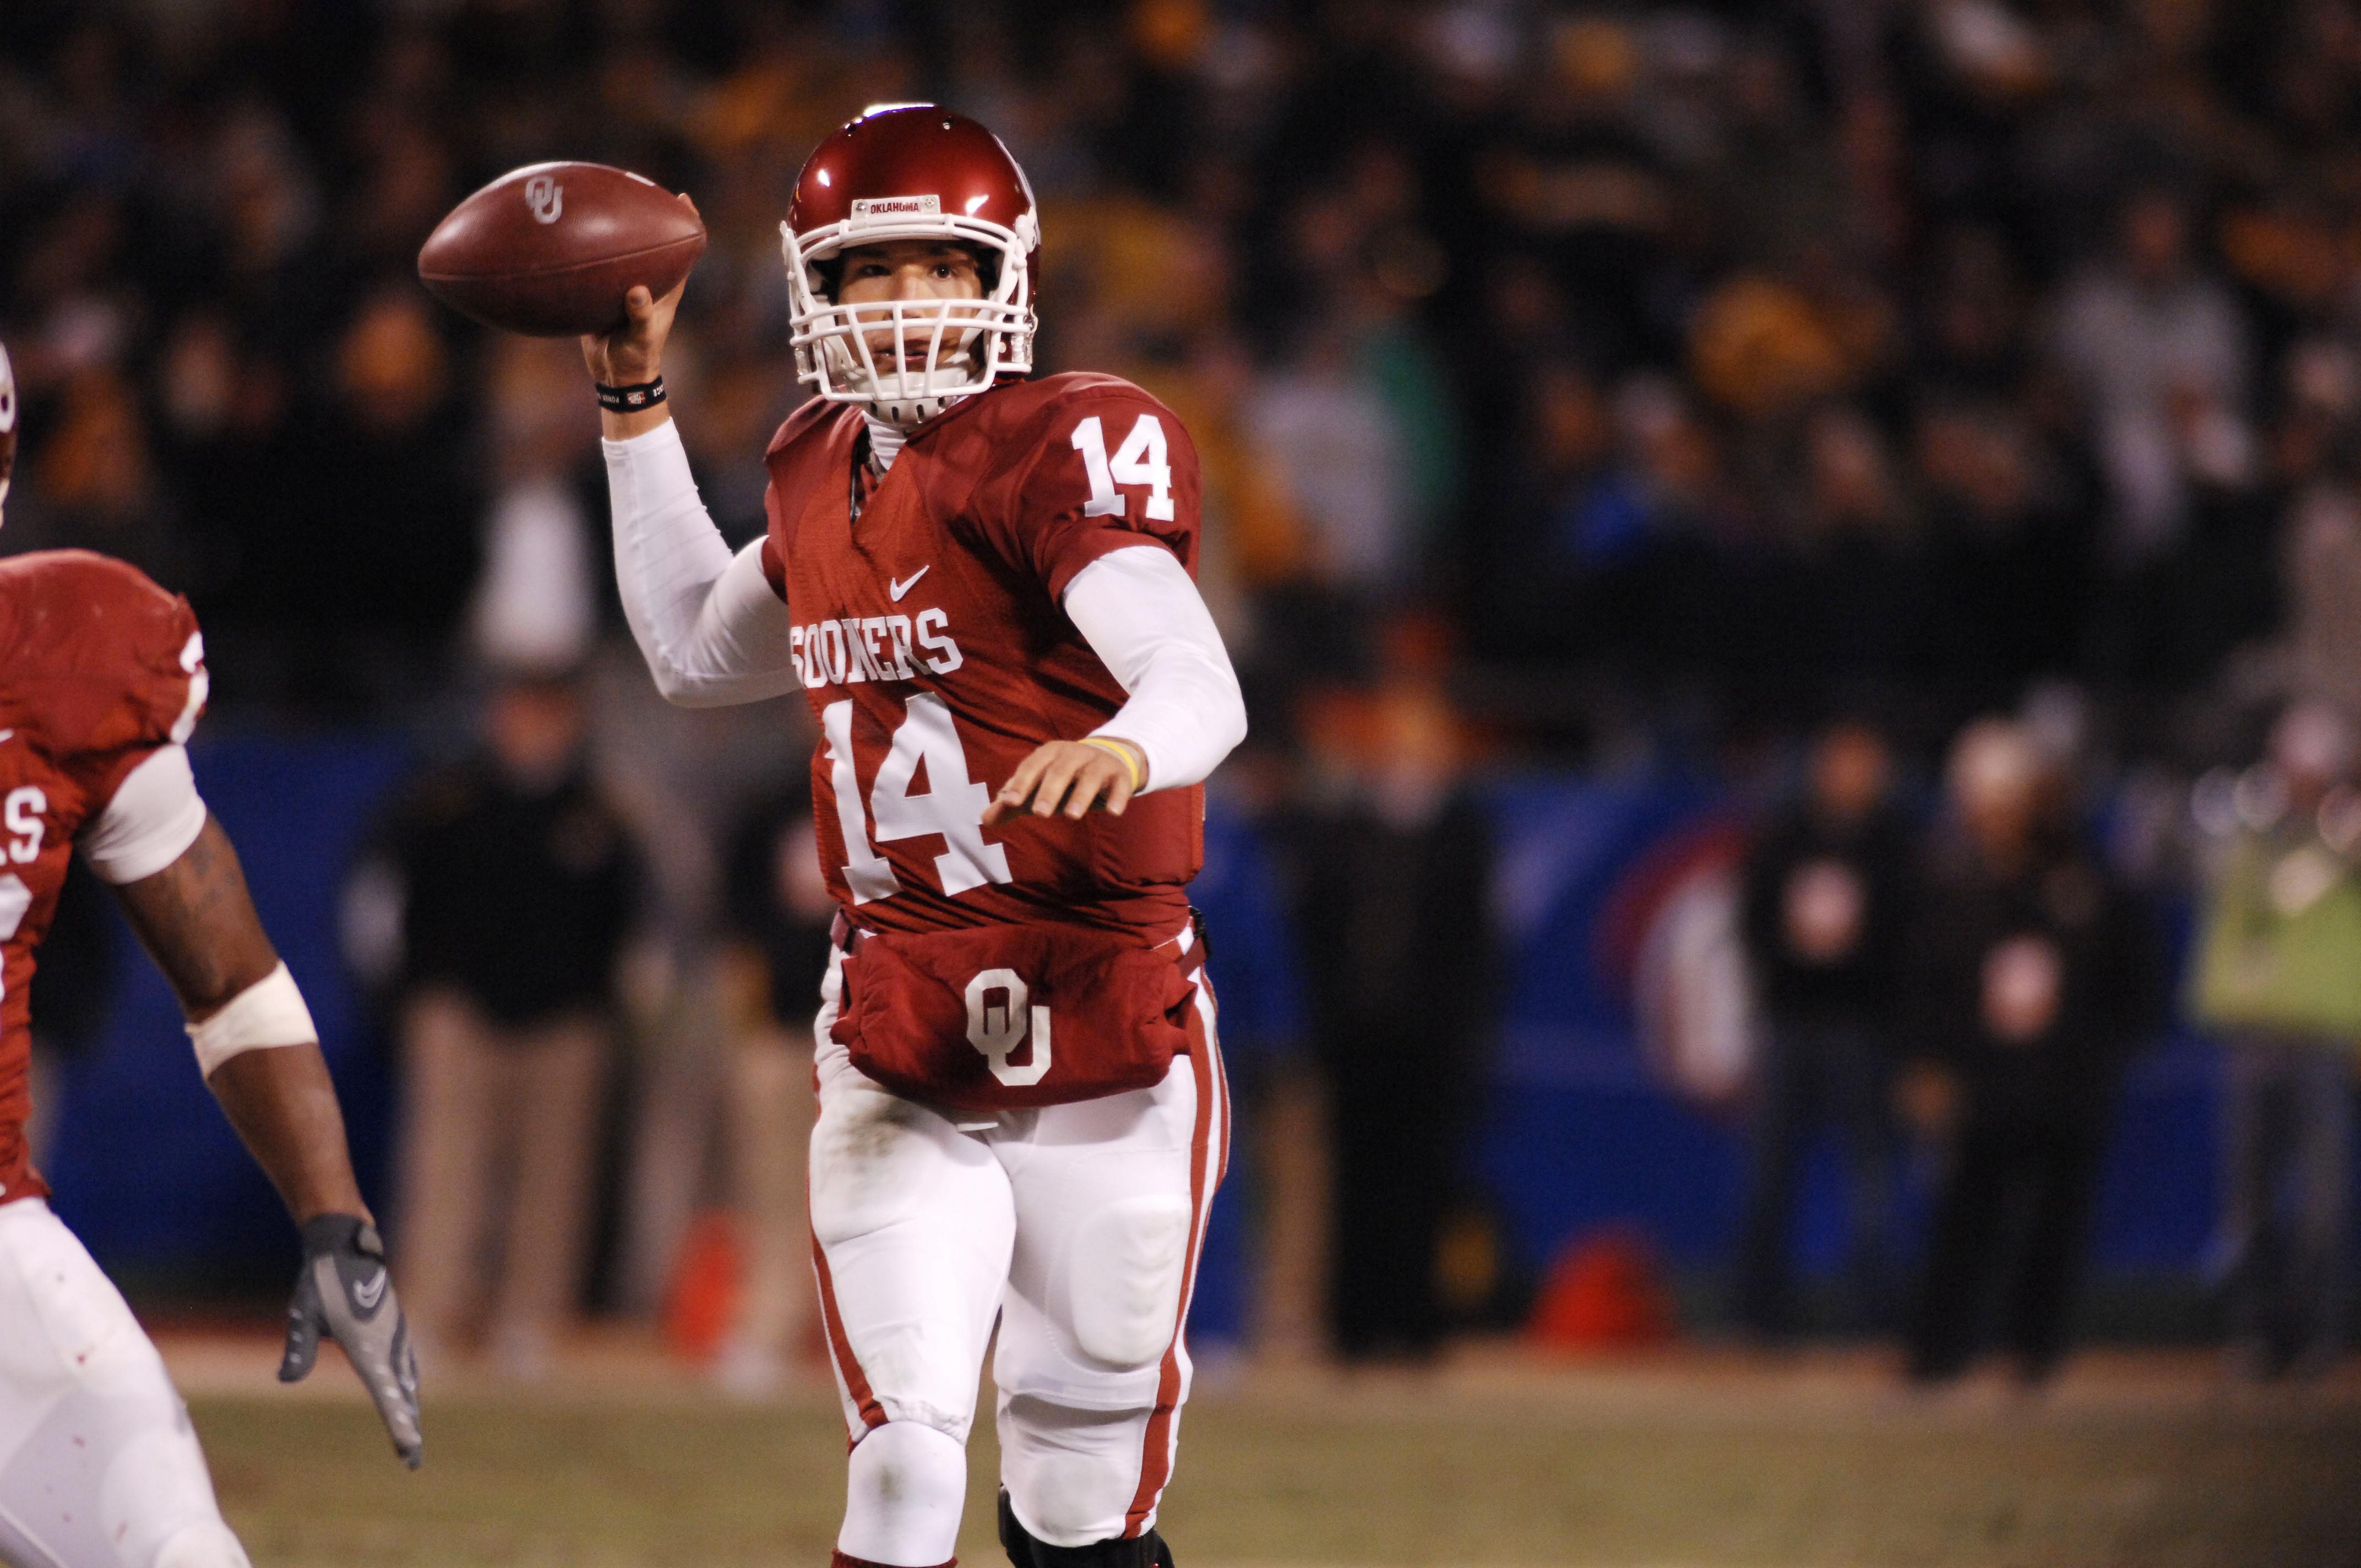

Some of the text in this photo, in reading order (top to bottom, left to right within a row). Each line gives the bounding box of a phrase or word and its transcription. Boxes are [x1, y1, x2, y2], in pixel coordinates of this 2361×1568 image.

[525, 176, 563, 224] OU
[871, 202, 919, 214] OKLAHOMA
[1071, 414, 1174, 521] 14
[791, 608, 963, 688] SOONERS
[822, 692, 1012, 905] 14
[965, 968, 1051, 1086] OU
